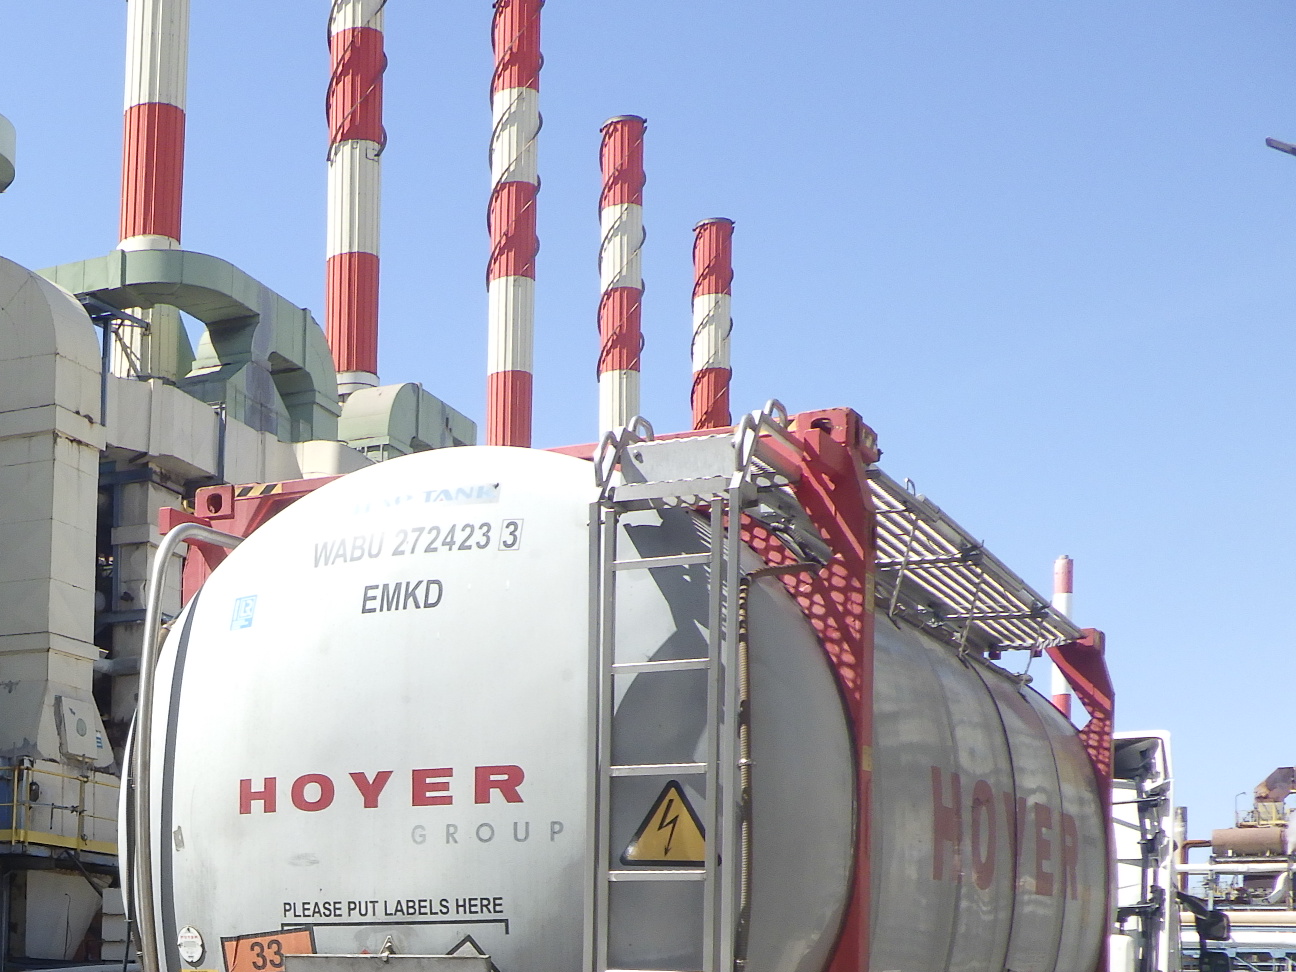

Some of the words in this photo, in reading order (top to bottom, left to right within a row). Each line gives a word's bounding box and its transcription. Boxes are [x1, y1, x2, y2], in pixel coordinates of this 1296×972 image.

[314, 532, 385, 568] WABU
[391, 522, 492, 557] 272423
[502, 520, 519, 549] 3
[361, 579, 443, 614] EMKD
[239, 764, 525, 815] HOYER
[411, 821, 565, 845] GROUP
[931, 766, 1079, 900] HOYER
[283, 902, 343, 918] PLEASE
[347, 900, 379, 917] PUT
[384, 898, 450, 916] LABELS
[456, 897, 503, 915] HERE
[250, 939, 284, 971] 33
